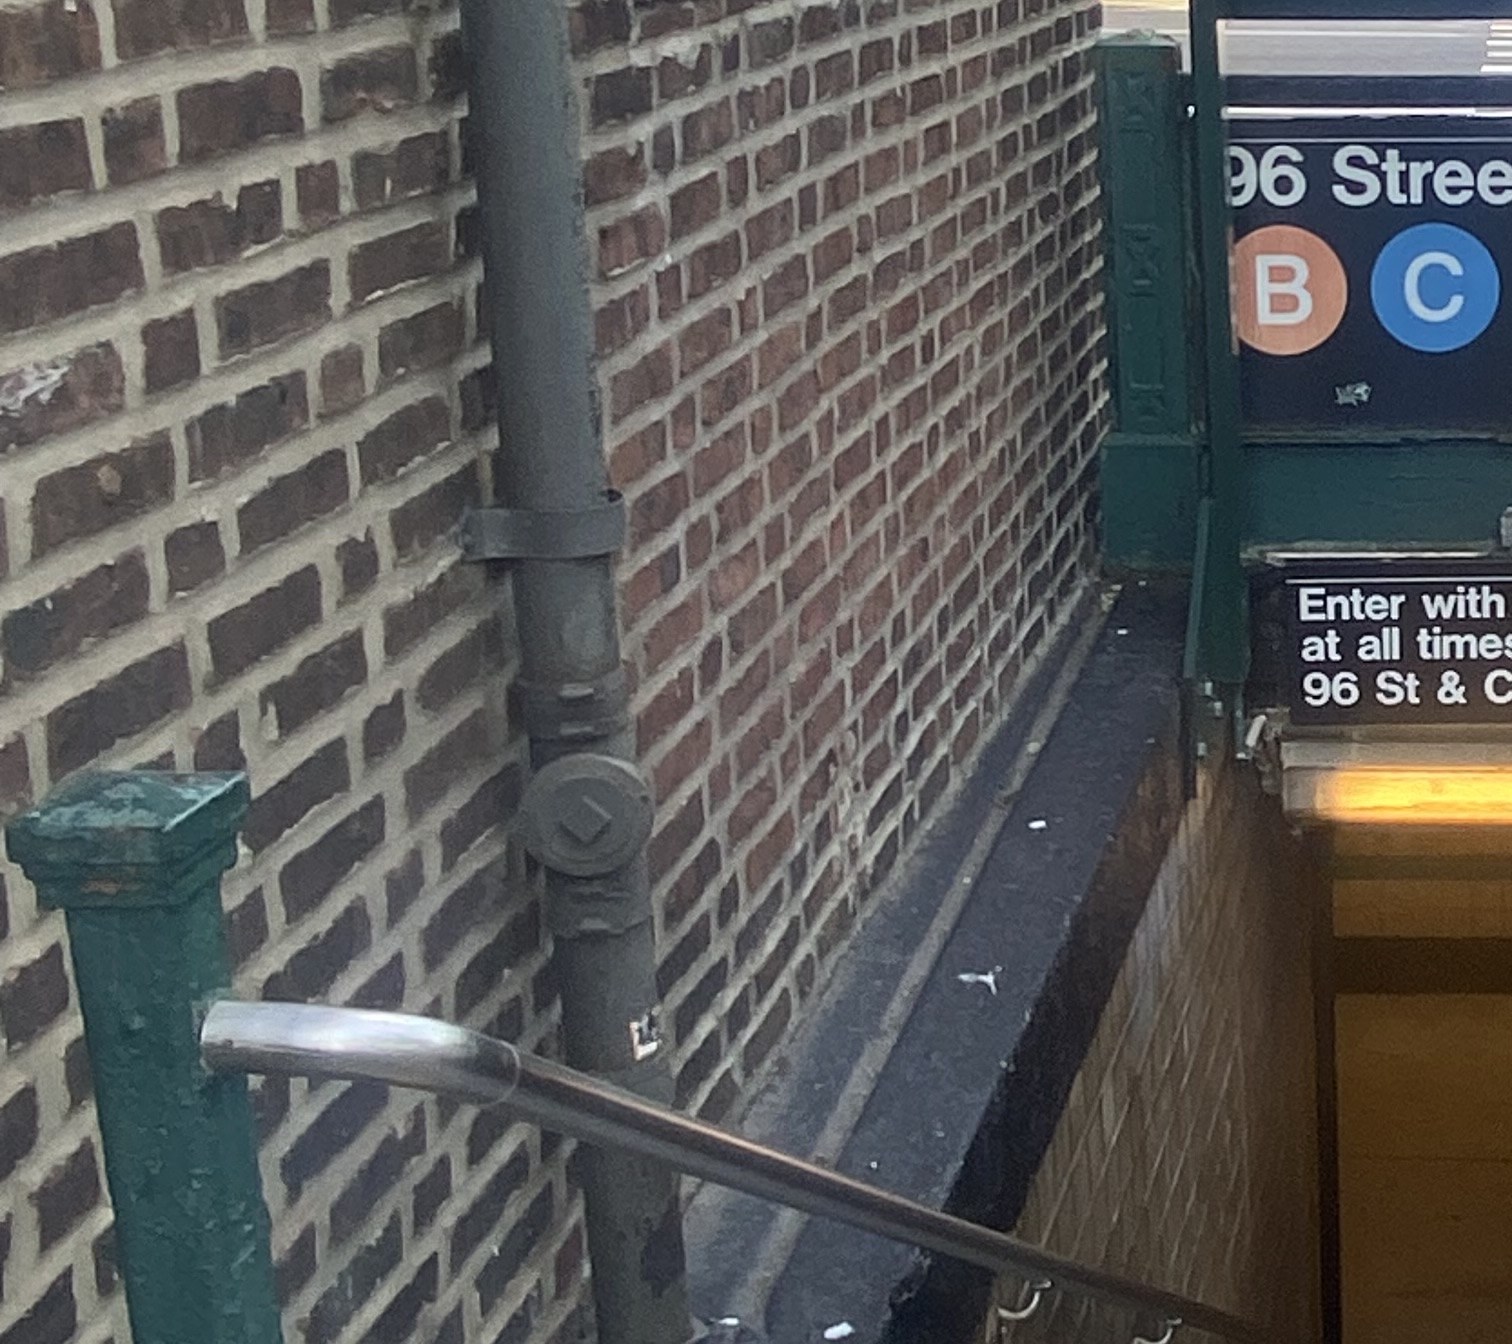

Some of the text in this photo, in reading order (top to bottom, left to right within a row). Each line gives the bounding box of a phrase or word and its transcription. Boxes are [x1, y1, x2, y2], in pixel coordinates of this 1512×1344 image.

[1228, 144, 1307, 207] 96
[1254, 253, 1314, 326] B
[1403, 250, 1465, 323] C
[1299, 586, 1406, 622] Enter
[1421, 585, 1506, 620] with
[1300, 629, 1342, 662] at
[1357, 626, 1401, 661] all
[1302, 671, 1360, 706] 96
[1375, 670, 1421, 705] St
[1436, 670, 1468, 705] &
